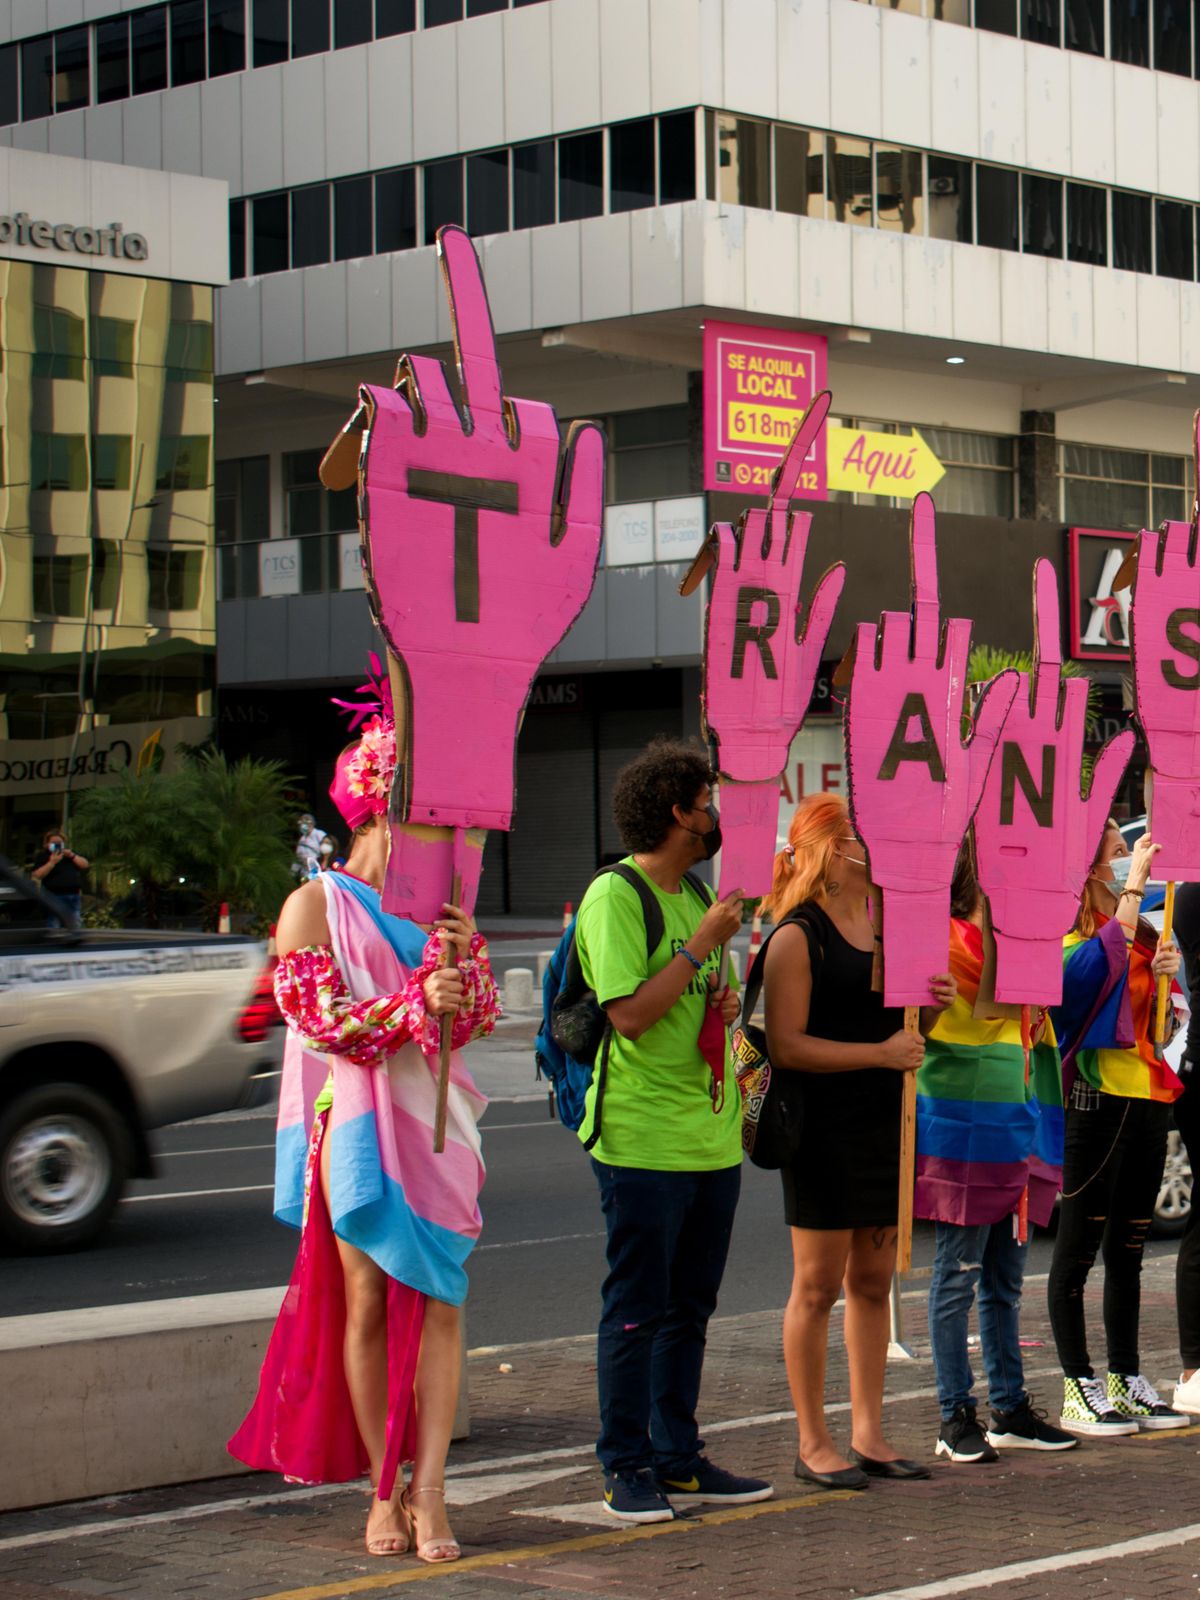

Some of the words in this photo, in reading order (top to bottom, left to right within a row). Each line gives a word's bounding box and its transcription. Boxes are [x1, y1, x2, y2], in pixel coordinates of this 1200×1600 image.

[727, 352, 746, 371] SE
[748, 356, 806, 379] ALQUILA
[736, 371, 797, 401] LOCAL
[842, 434, 919, 489] Aquí
[406, 468, 519, 623] T
[729, 587, 781, 680] R
[877, 692, 947, 782] A
[999, 742, 1057, 828] N
